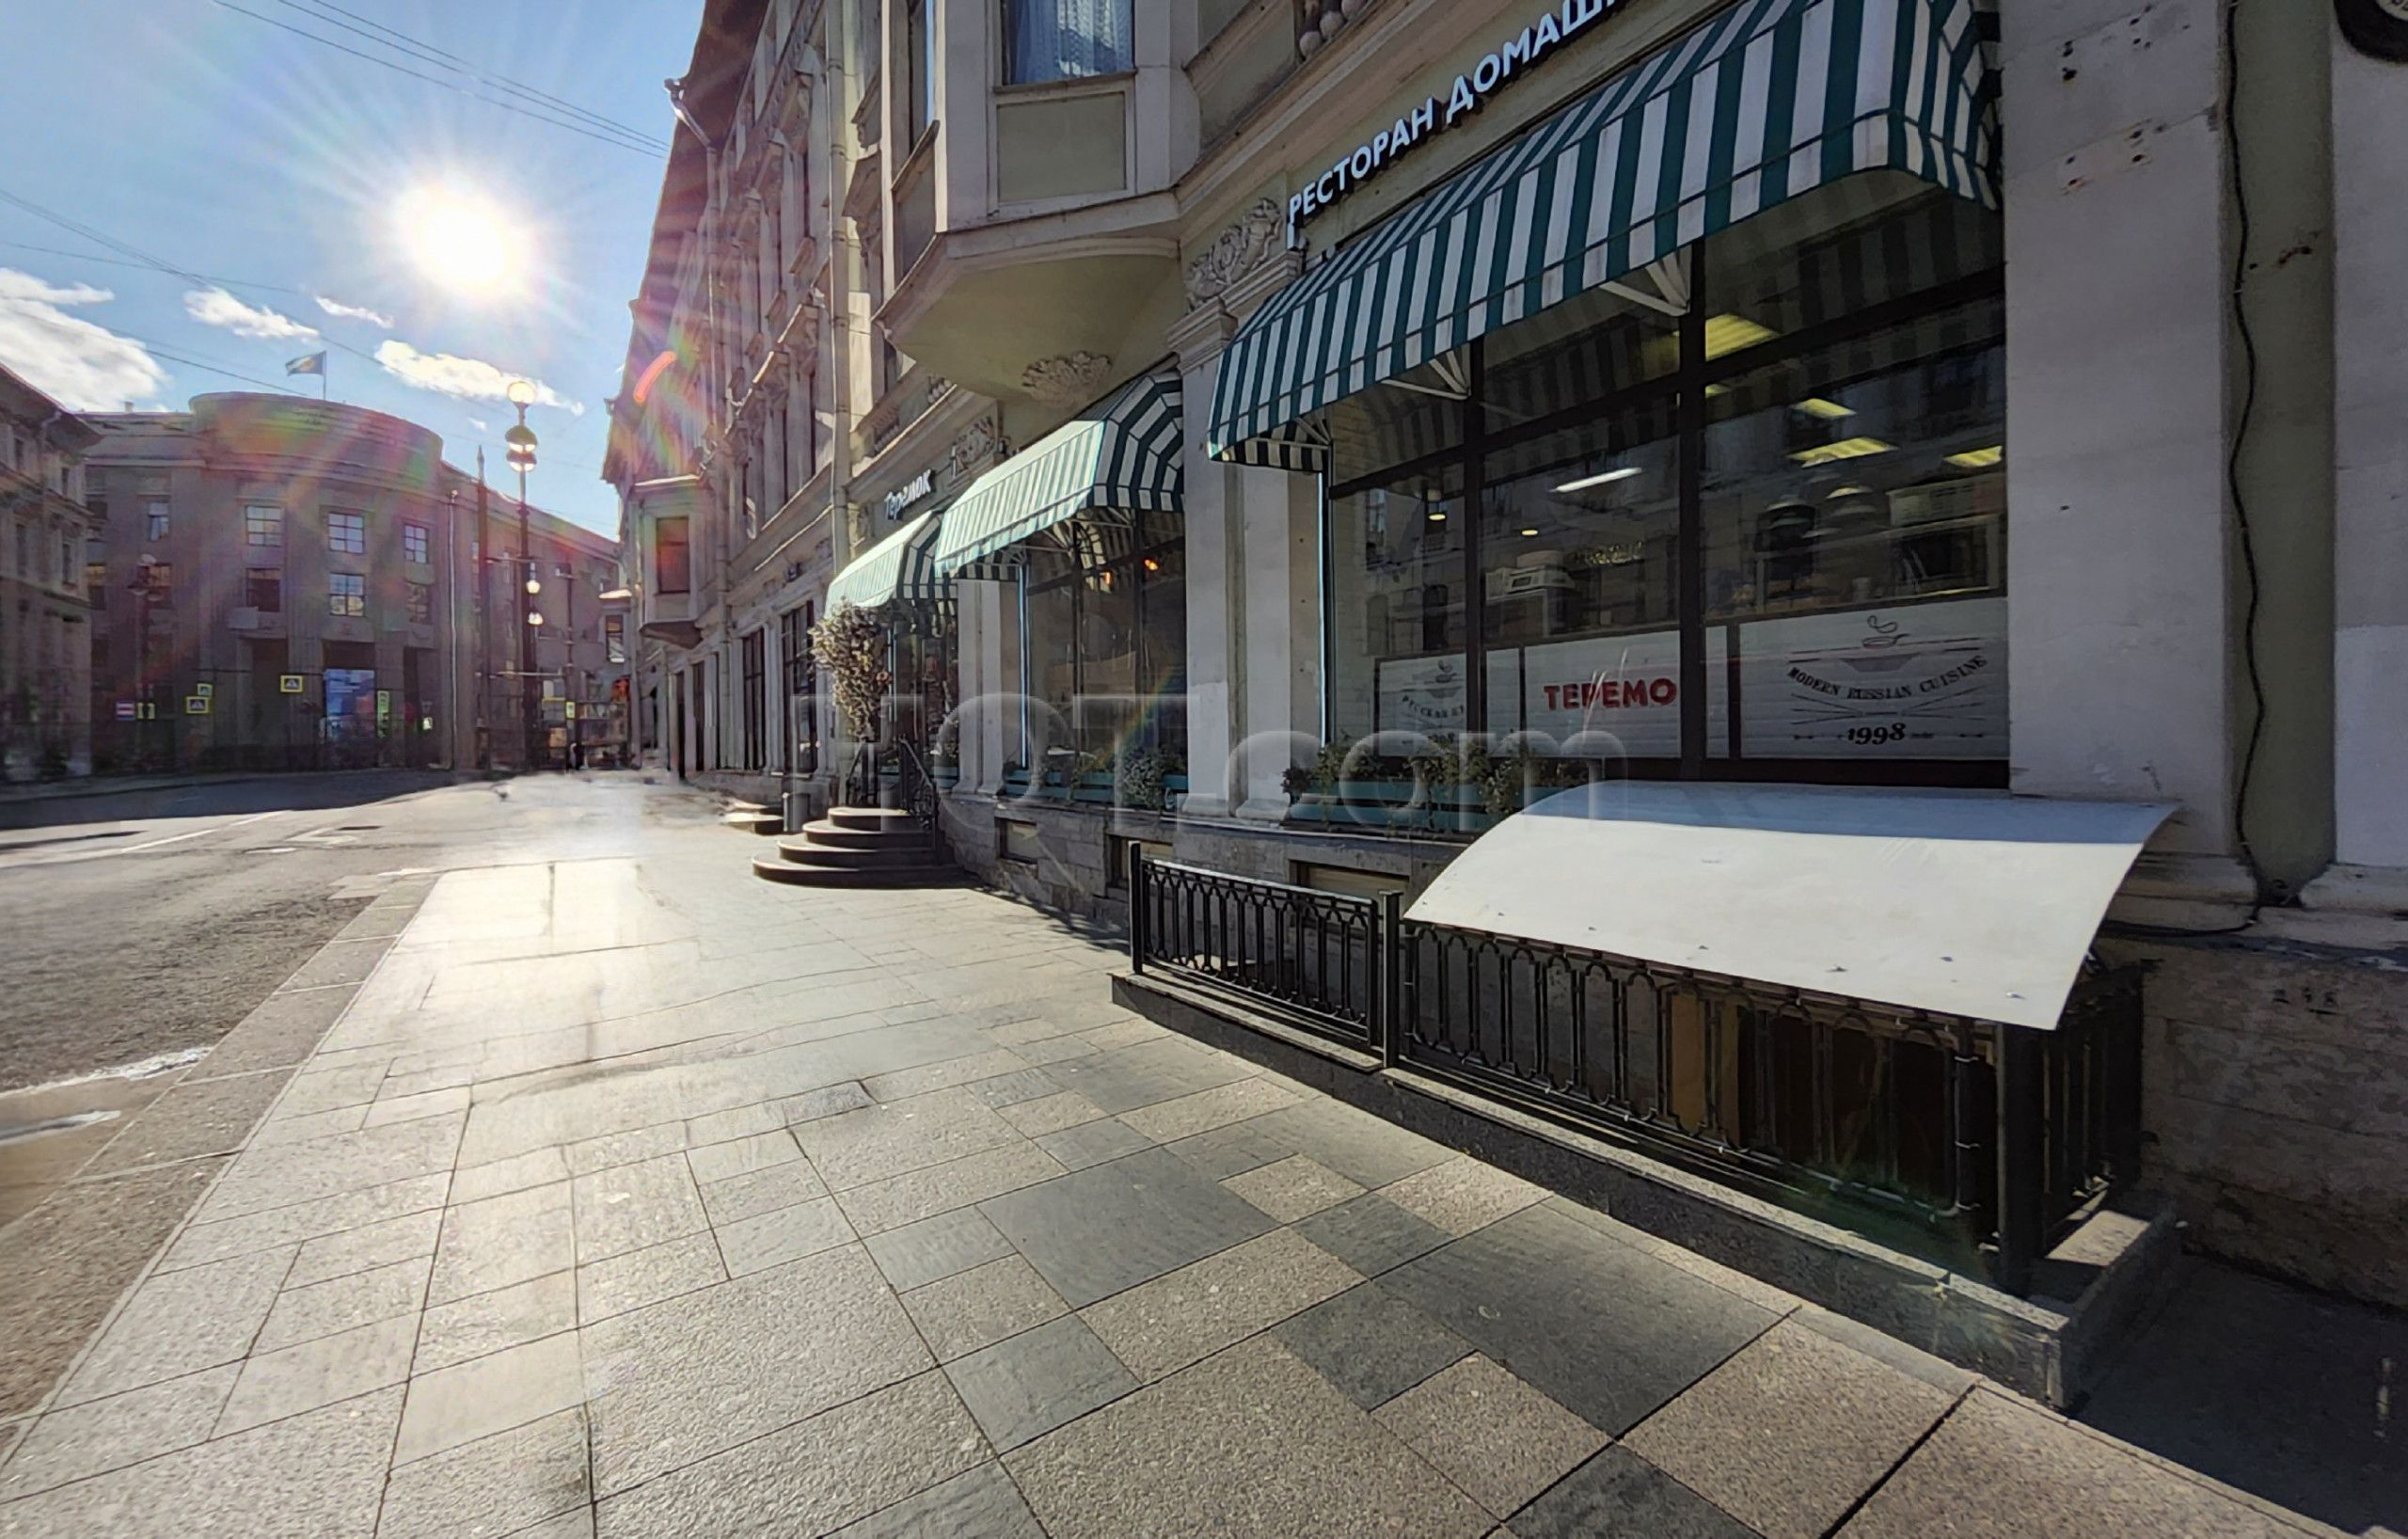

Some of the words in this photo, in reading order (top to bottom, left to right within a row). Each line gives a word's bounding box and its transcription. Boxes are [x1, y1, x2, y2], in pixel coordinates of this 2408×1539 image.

[1289, 98, 1434, 224] РЕСТОРАН
[1446, 0, 1616, 124] ДОМАШ
[1787, 667, 1841, 696] MODERN
[1846, 685, 1912, 700] RUSSIAN
[1919, 655, 1988, 693] CUISINE
[1846, 722, 1907, 745] 1998
